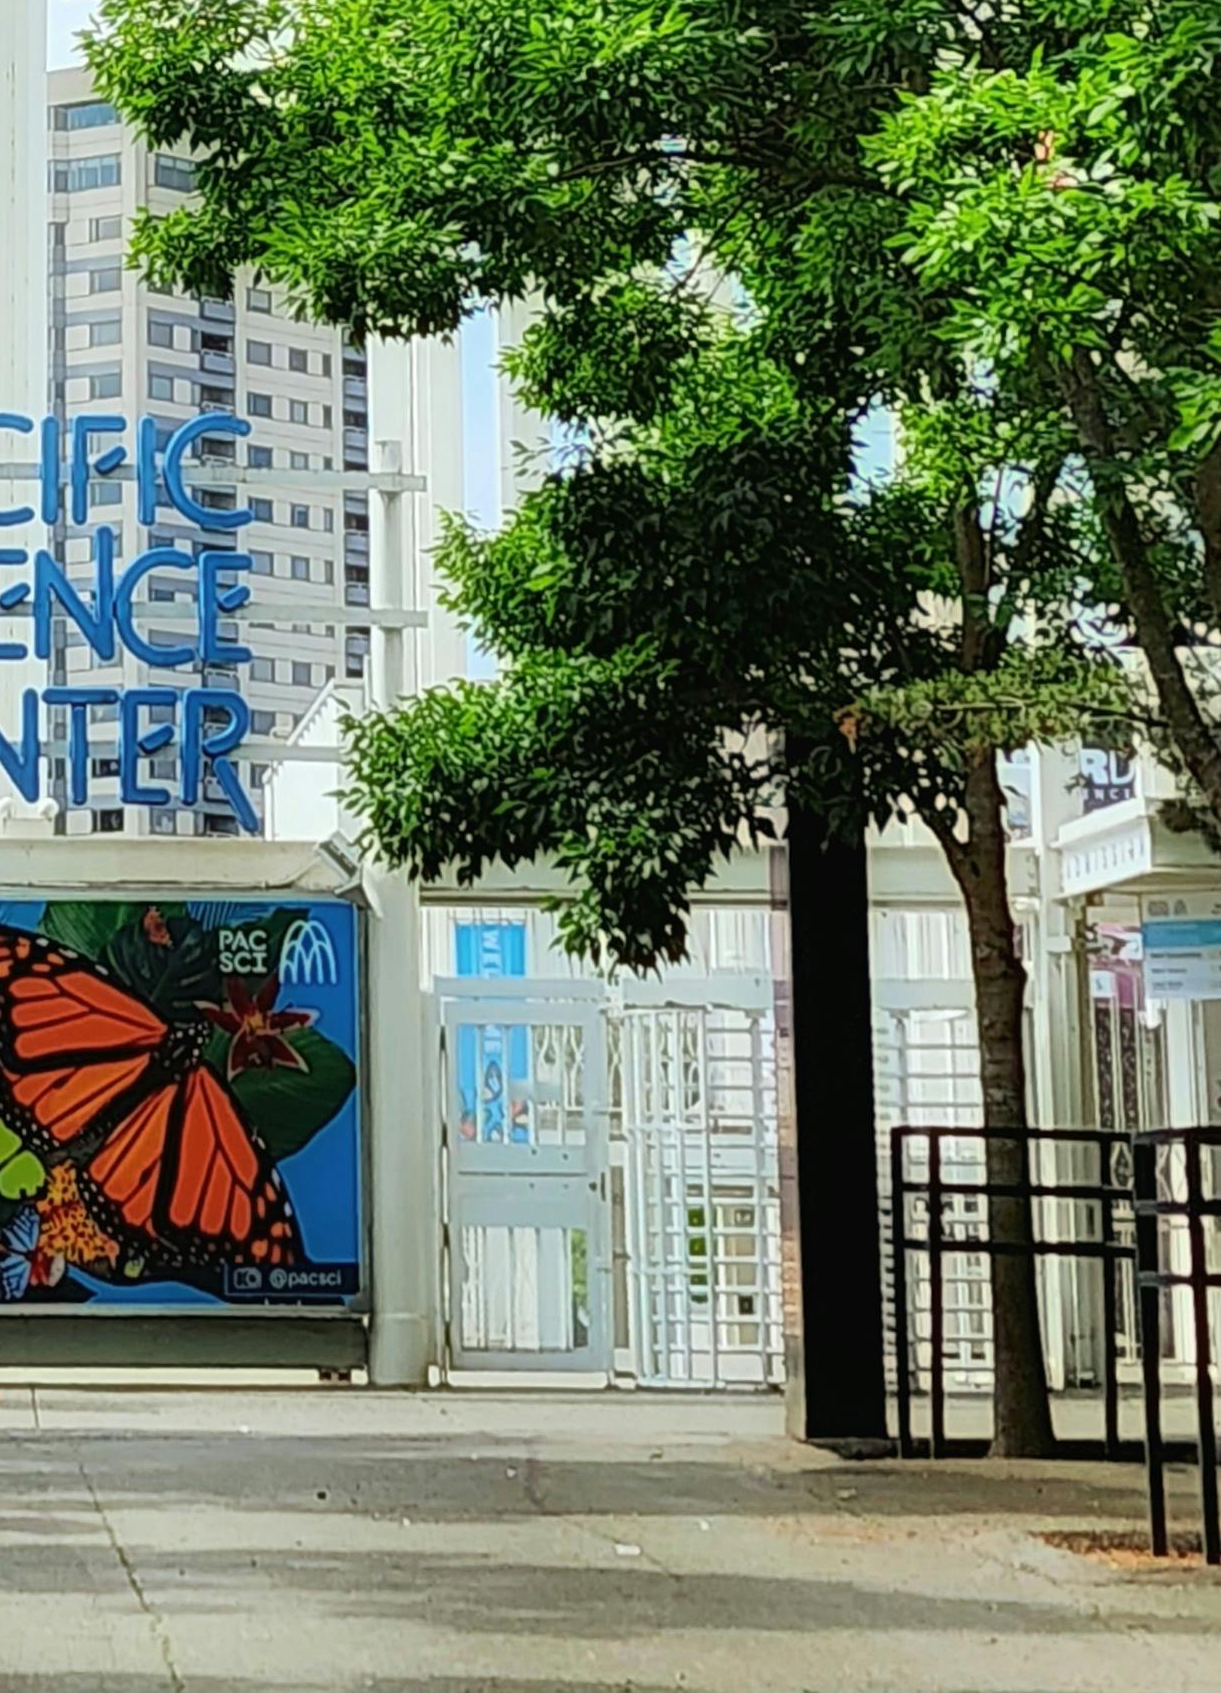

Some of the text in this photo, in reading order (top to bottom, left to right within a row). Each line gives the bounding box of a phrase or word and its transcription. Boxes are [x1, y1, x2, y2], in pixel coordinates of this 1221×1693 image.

[219, 930, 267, 951] PAC
[219, 952, 268, 973] SCI
[269, 1268, 341, 1289] @pacsci
